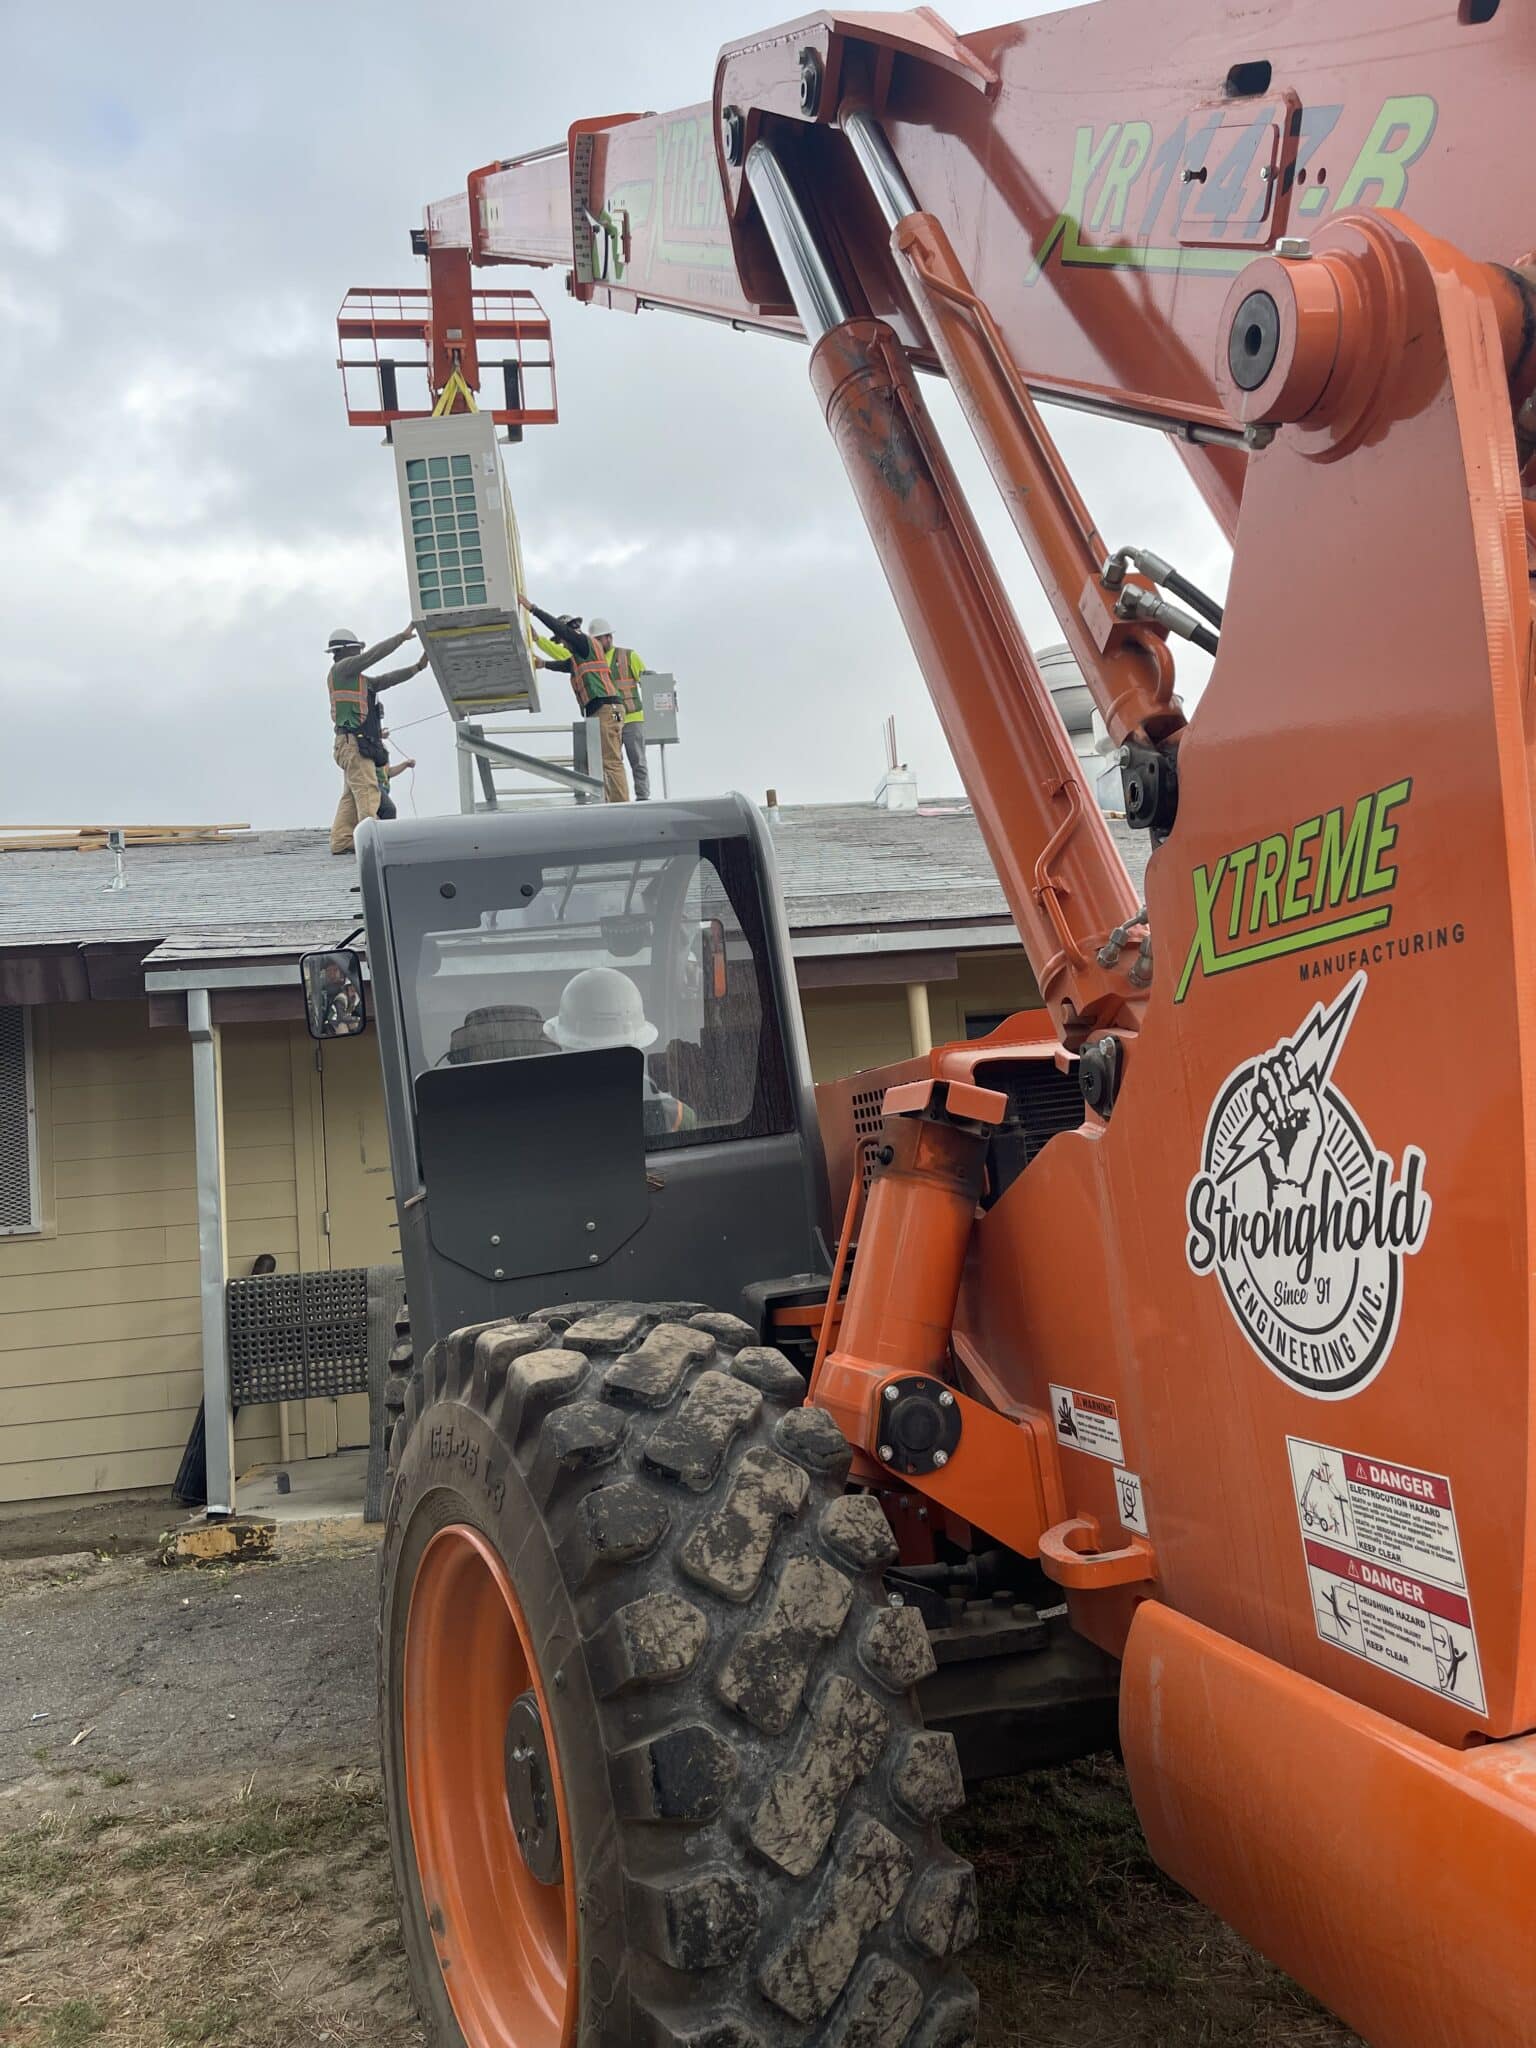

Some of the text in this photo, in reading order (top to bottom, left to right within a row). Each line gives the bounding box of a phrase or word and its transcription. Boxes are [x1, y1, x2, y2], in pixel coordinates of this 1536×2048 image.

[1174, 777, 1412, 1003] XTREME
[1299, 923, 1465, 981] MANUFACTURING
[1189, 1153, 1426, 1284] Stronghold
[1273, 1280, 1308, 1307] Since
[1236, 1278, 1385, 1374] ENGINEERING INC.
[1369, 1465, 1435, 1499] DANGER
[1349, 1484, 1441, 1518] ELECTROCUTION HAZARD
[1359, 1541, 1401, 1563] KEEP CLEAR
[1361, 1565, 1425, 1604] DANGER
[1359, 1595, 1426, 1629] CRUSHING HAZARD
[1366, 1639, 1409, 1665] KEEP CLEAR
